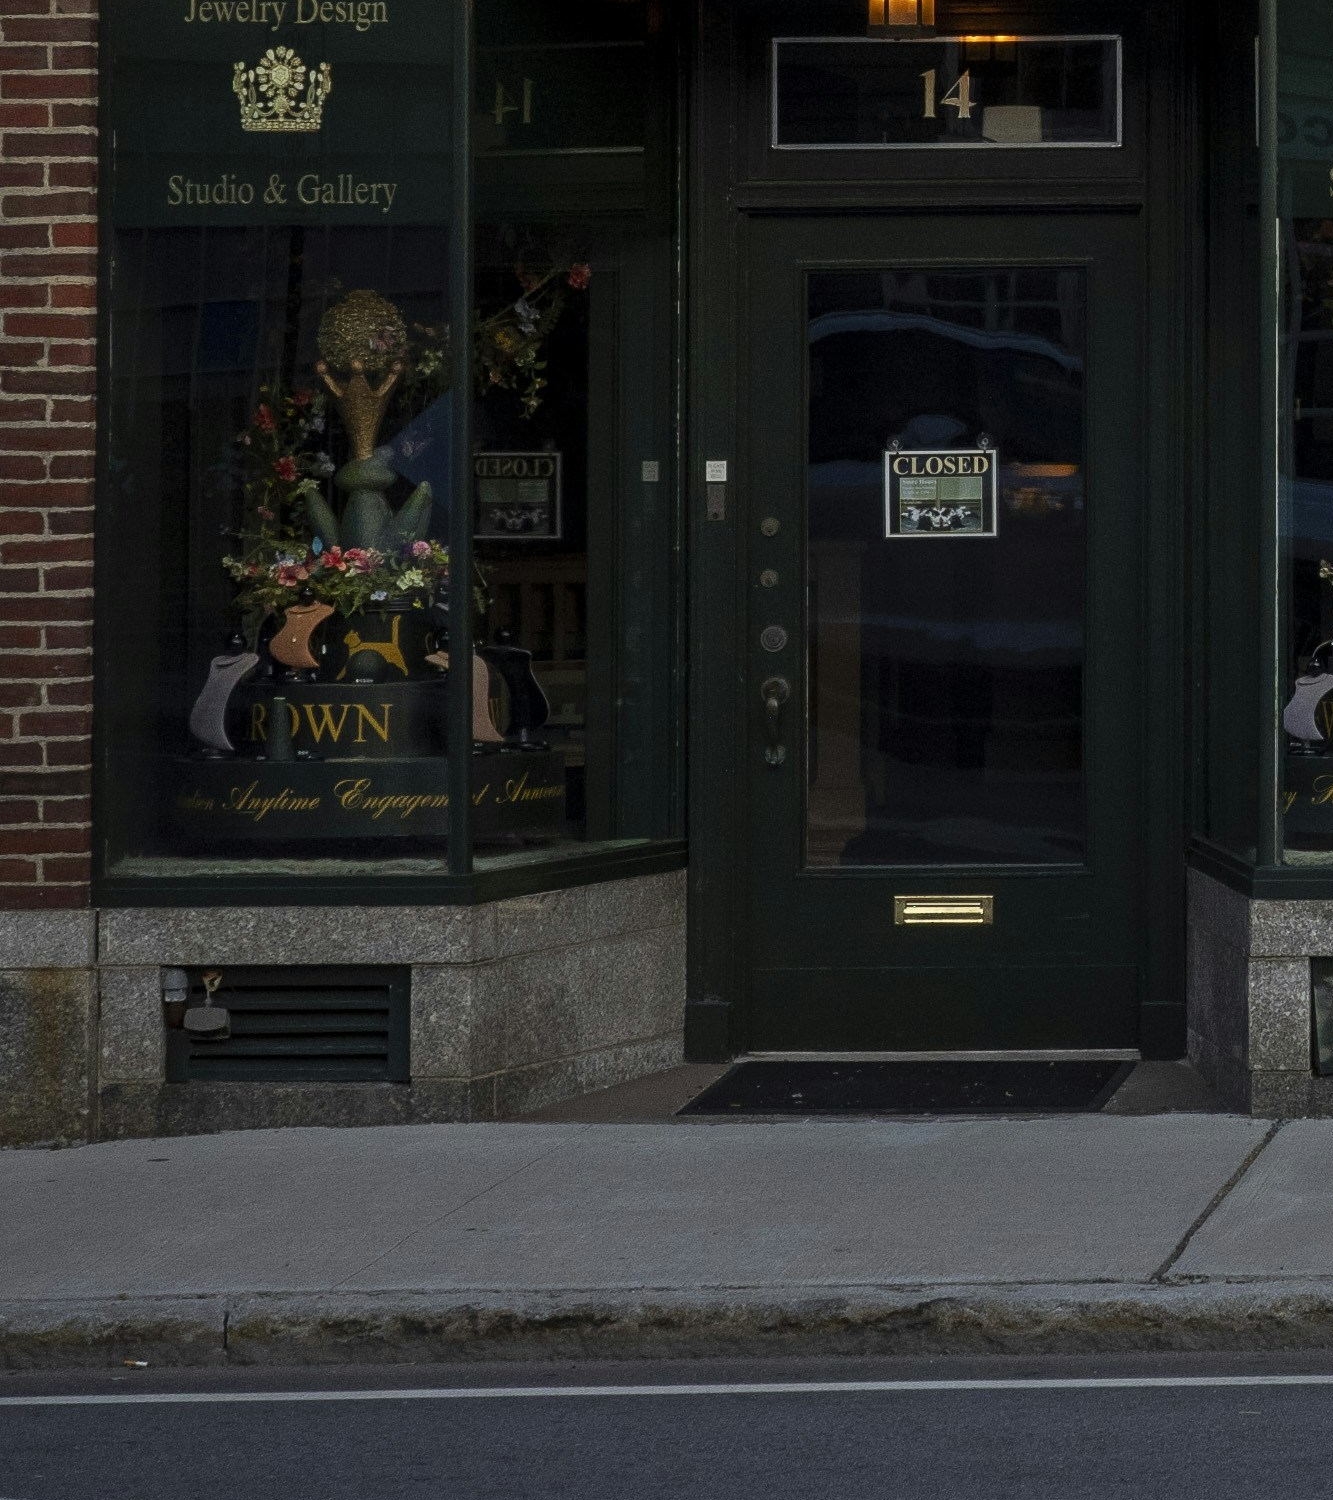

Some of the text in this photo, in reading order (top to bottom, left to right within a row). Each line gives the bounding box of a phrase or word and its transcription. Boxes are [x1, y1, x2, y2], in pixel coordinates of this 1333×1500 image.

[918, 67, 976, 119] 14
[167, 174, 398, 214] Studio & Gallery
[892, 455, 989, 476] CLOSED
[221, 780, 322, 822] Anytime
